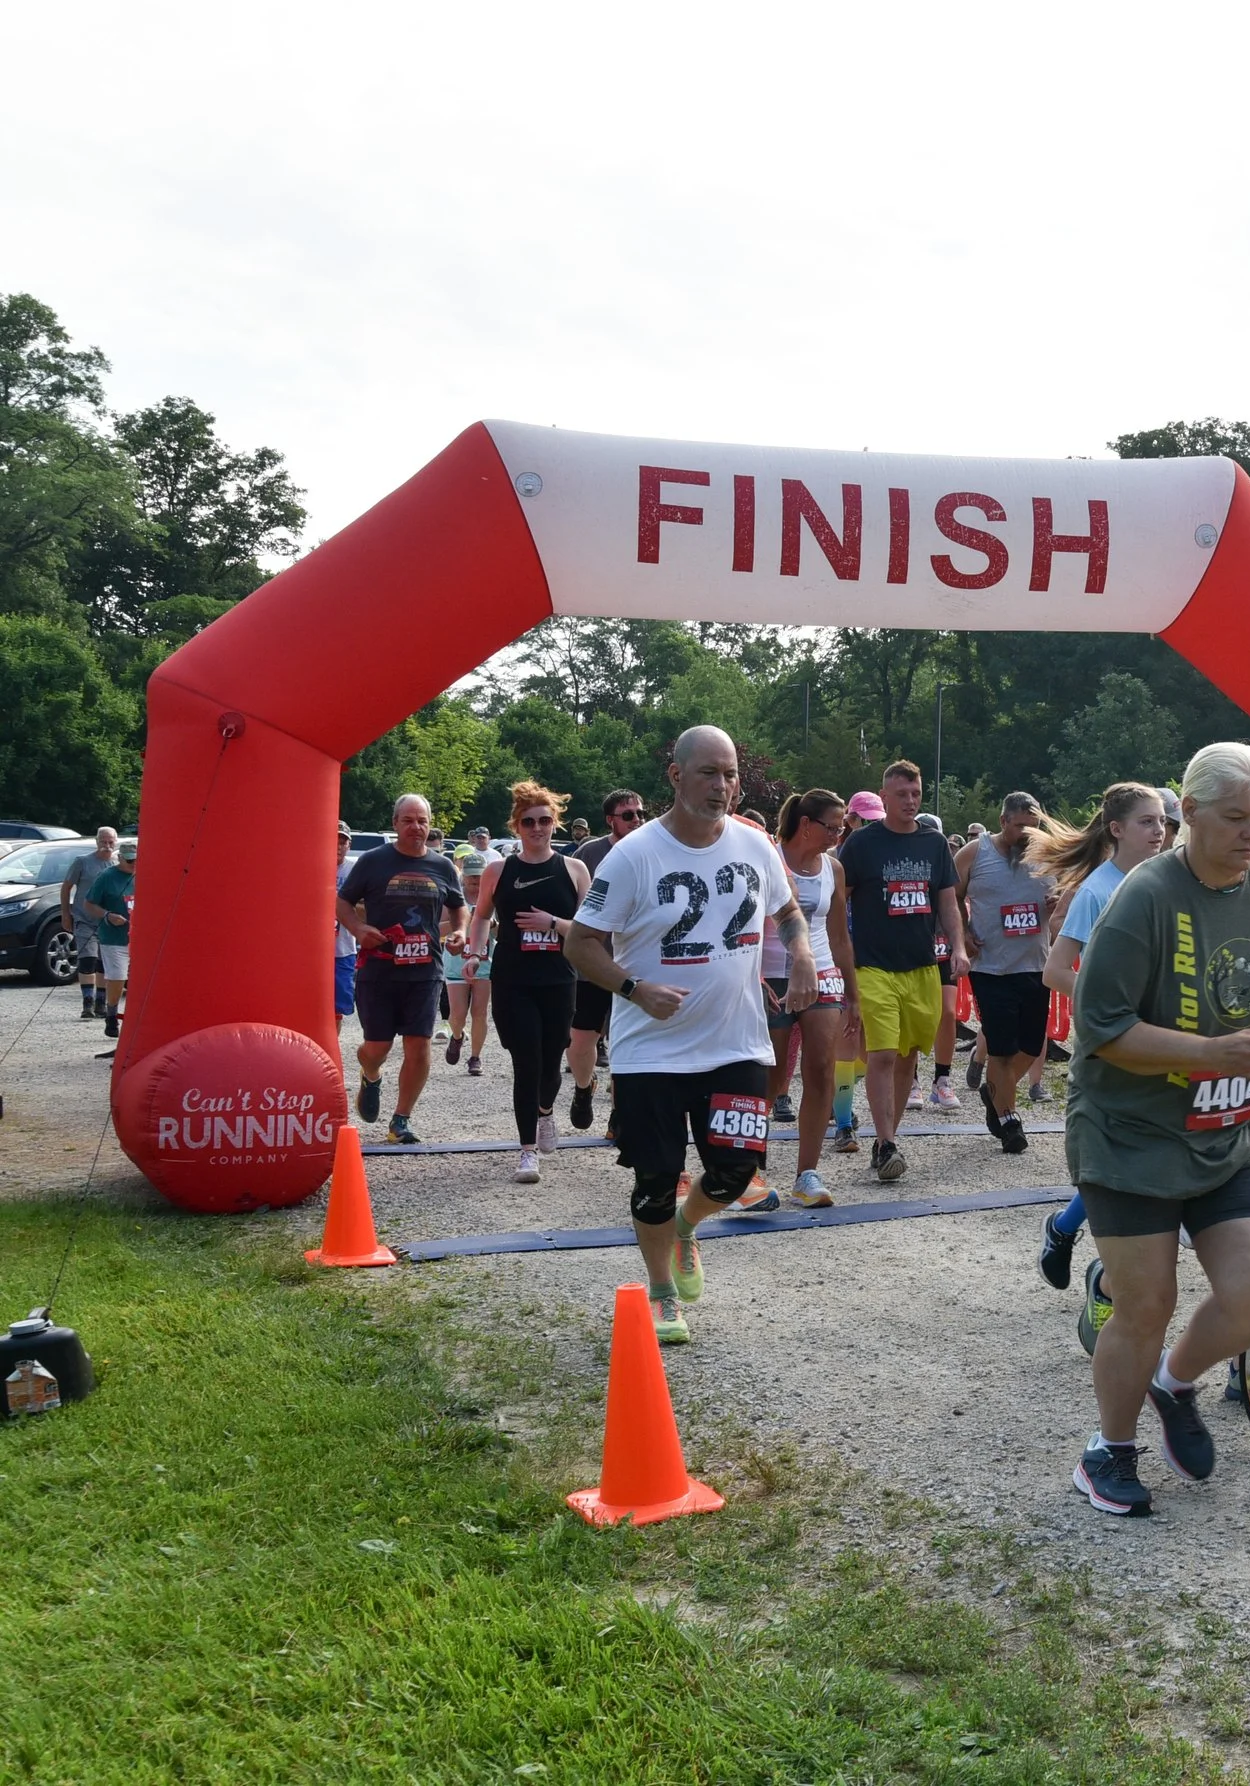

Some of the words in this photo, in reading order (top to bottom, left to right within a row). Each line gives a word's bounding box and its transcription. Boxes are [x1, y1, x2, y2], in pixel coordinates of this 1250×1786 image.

[637, 465, 1110, 594] FINISH
[656, 861, 761, 958] 22
[1004, 912, 1038, 929] 4423
[395, 942, 429, 957] 4425
[1173, 912, 1198, 976] Run
[182, 1088, 253, 1112] Can't
[259, 1087, 315, 1117] Stop
[730, 1101, 757, 1111] TIMING
[158, 1112, 333, 1150] RUNNING
[710, 1109, 767, 1139] 4365
[209, 1153, 289, 1165] COMPANY
